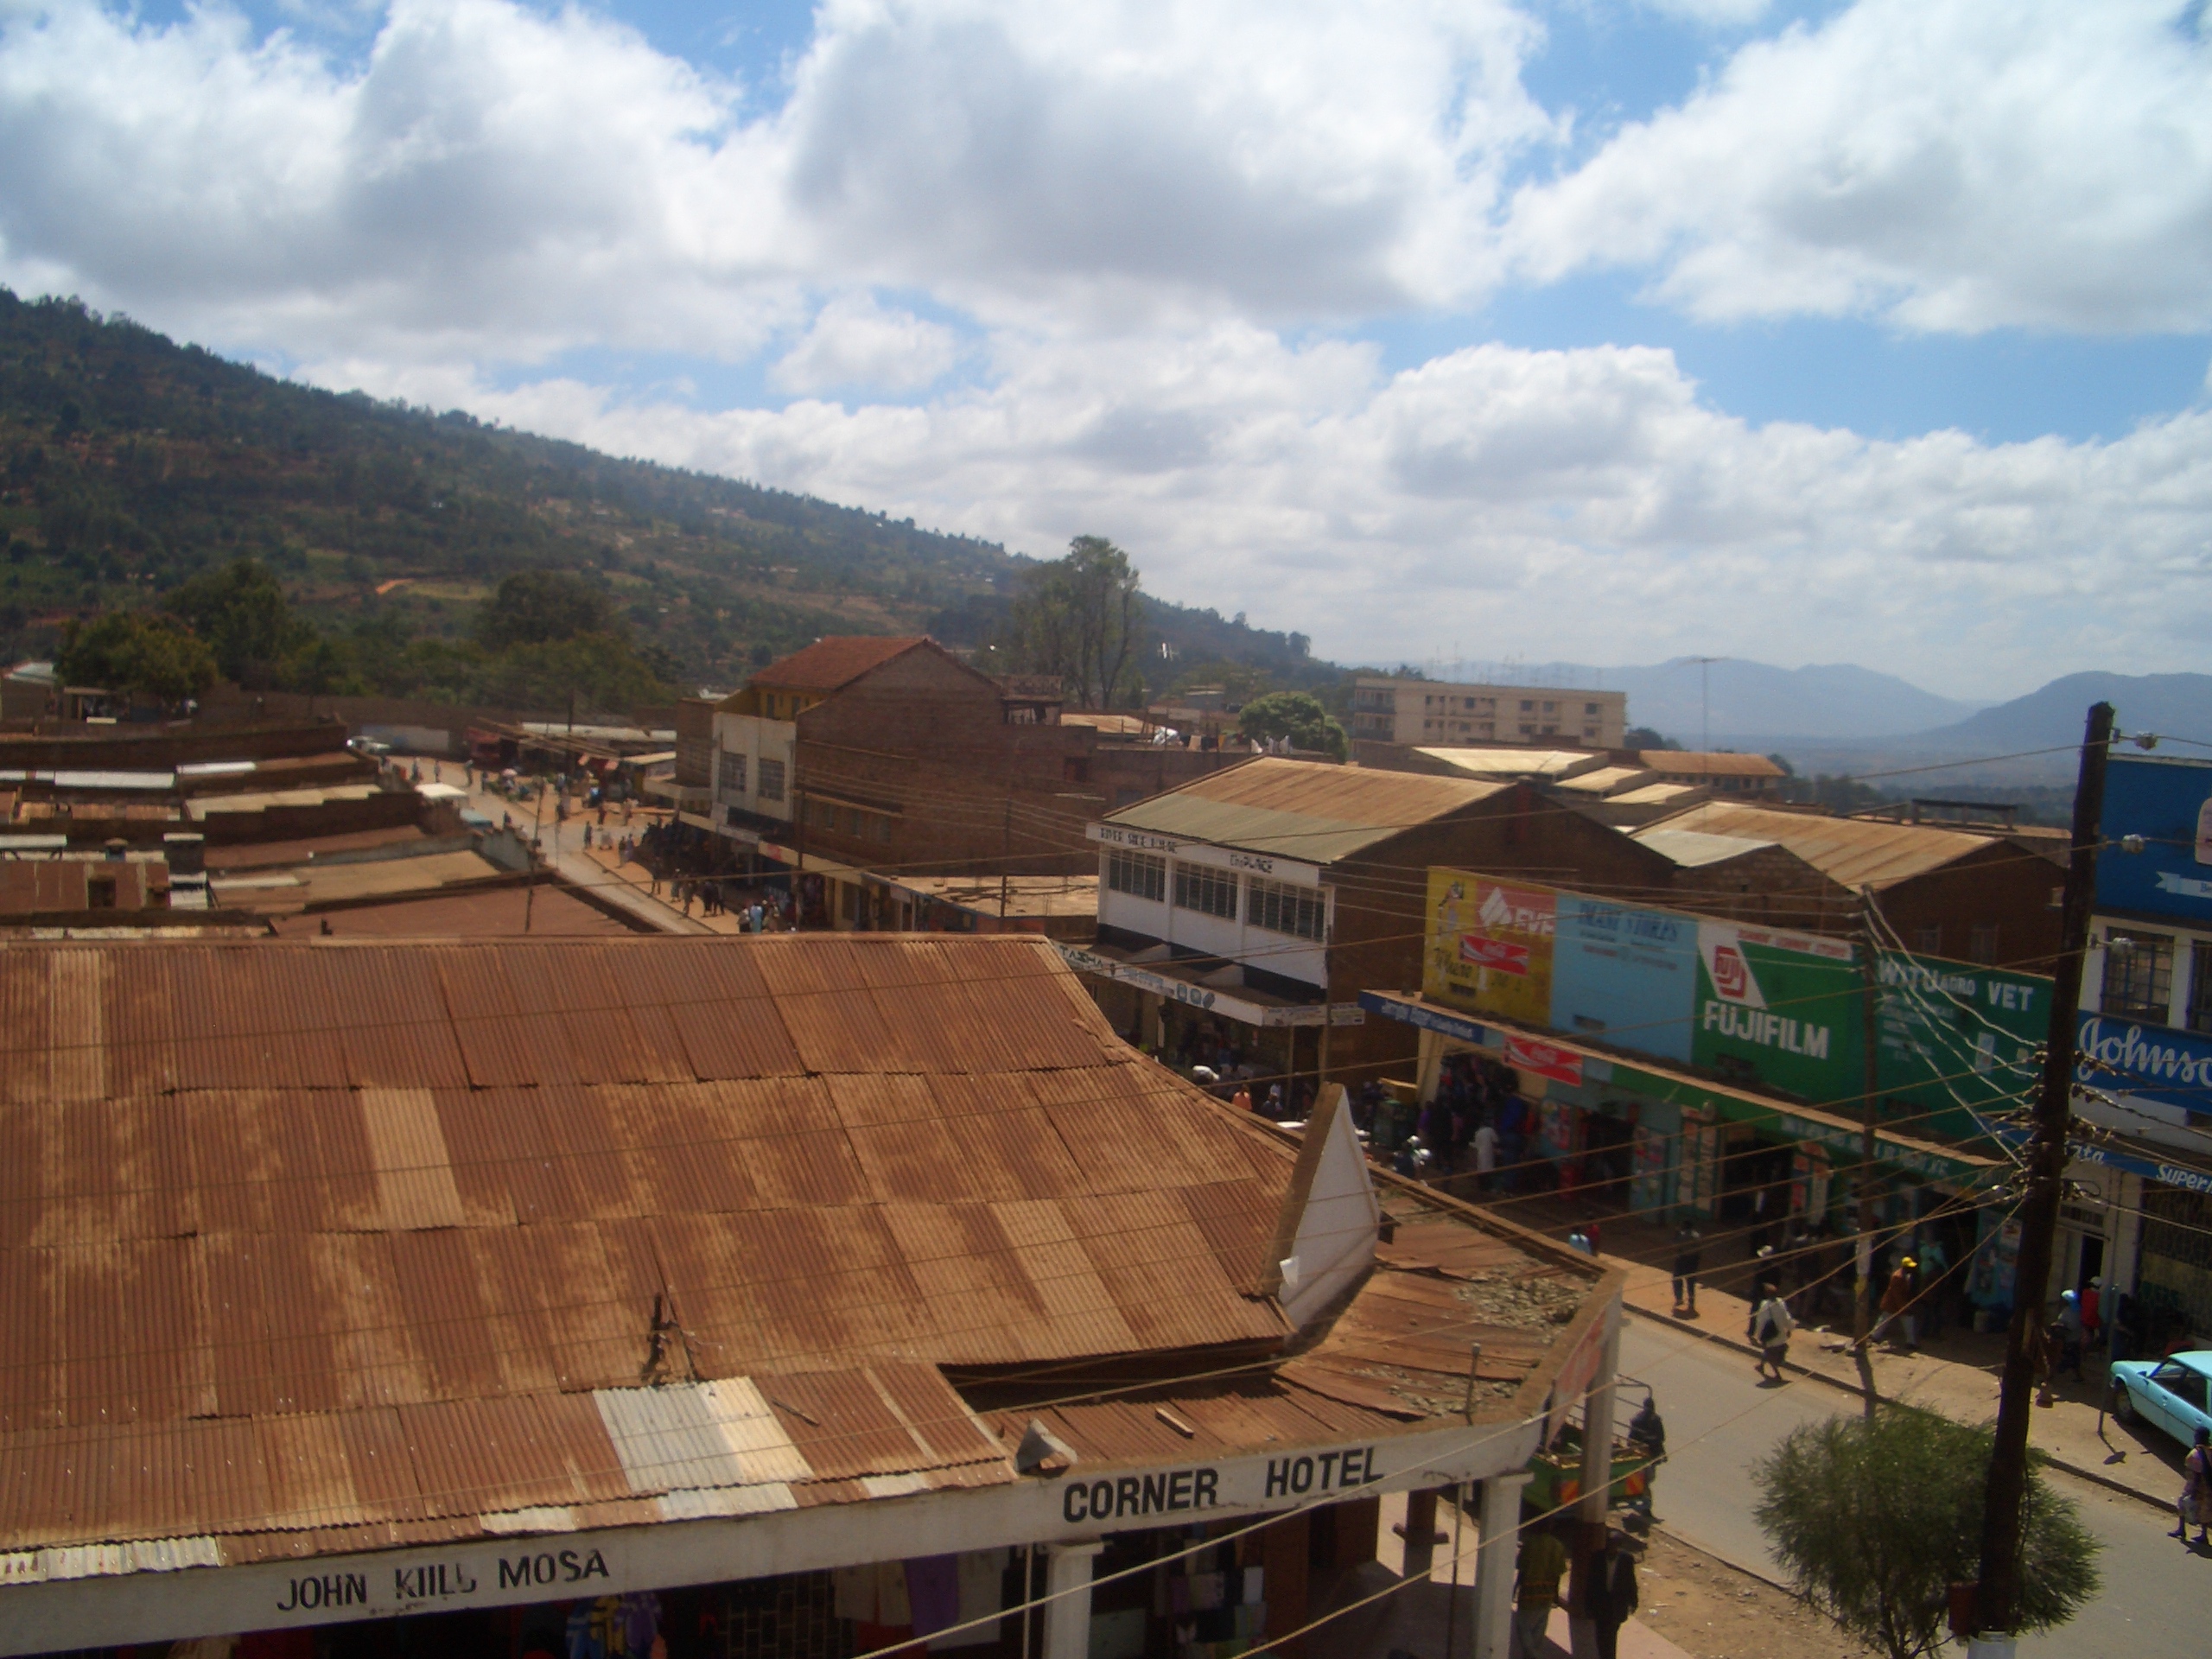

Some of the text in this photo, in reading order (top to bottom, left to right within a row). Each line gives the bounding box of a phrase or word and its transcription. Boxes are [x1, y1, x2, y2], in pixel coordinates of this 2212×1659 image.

[1987, 980, 2034, 1012] VET
[1703, 1000, 1830, 1060] FUJIFILM
[1063, 1446, 1384, 1523] CORNER HOTEL
[276, 1573, 368, 1612] JOHN
[497, 1548, 610, 1590] MOSA
